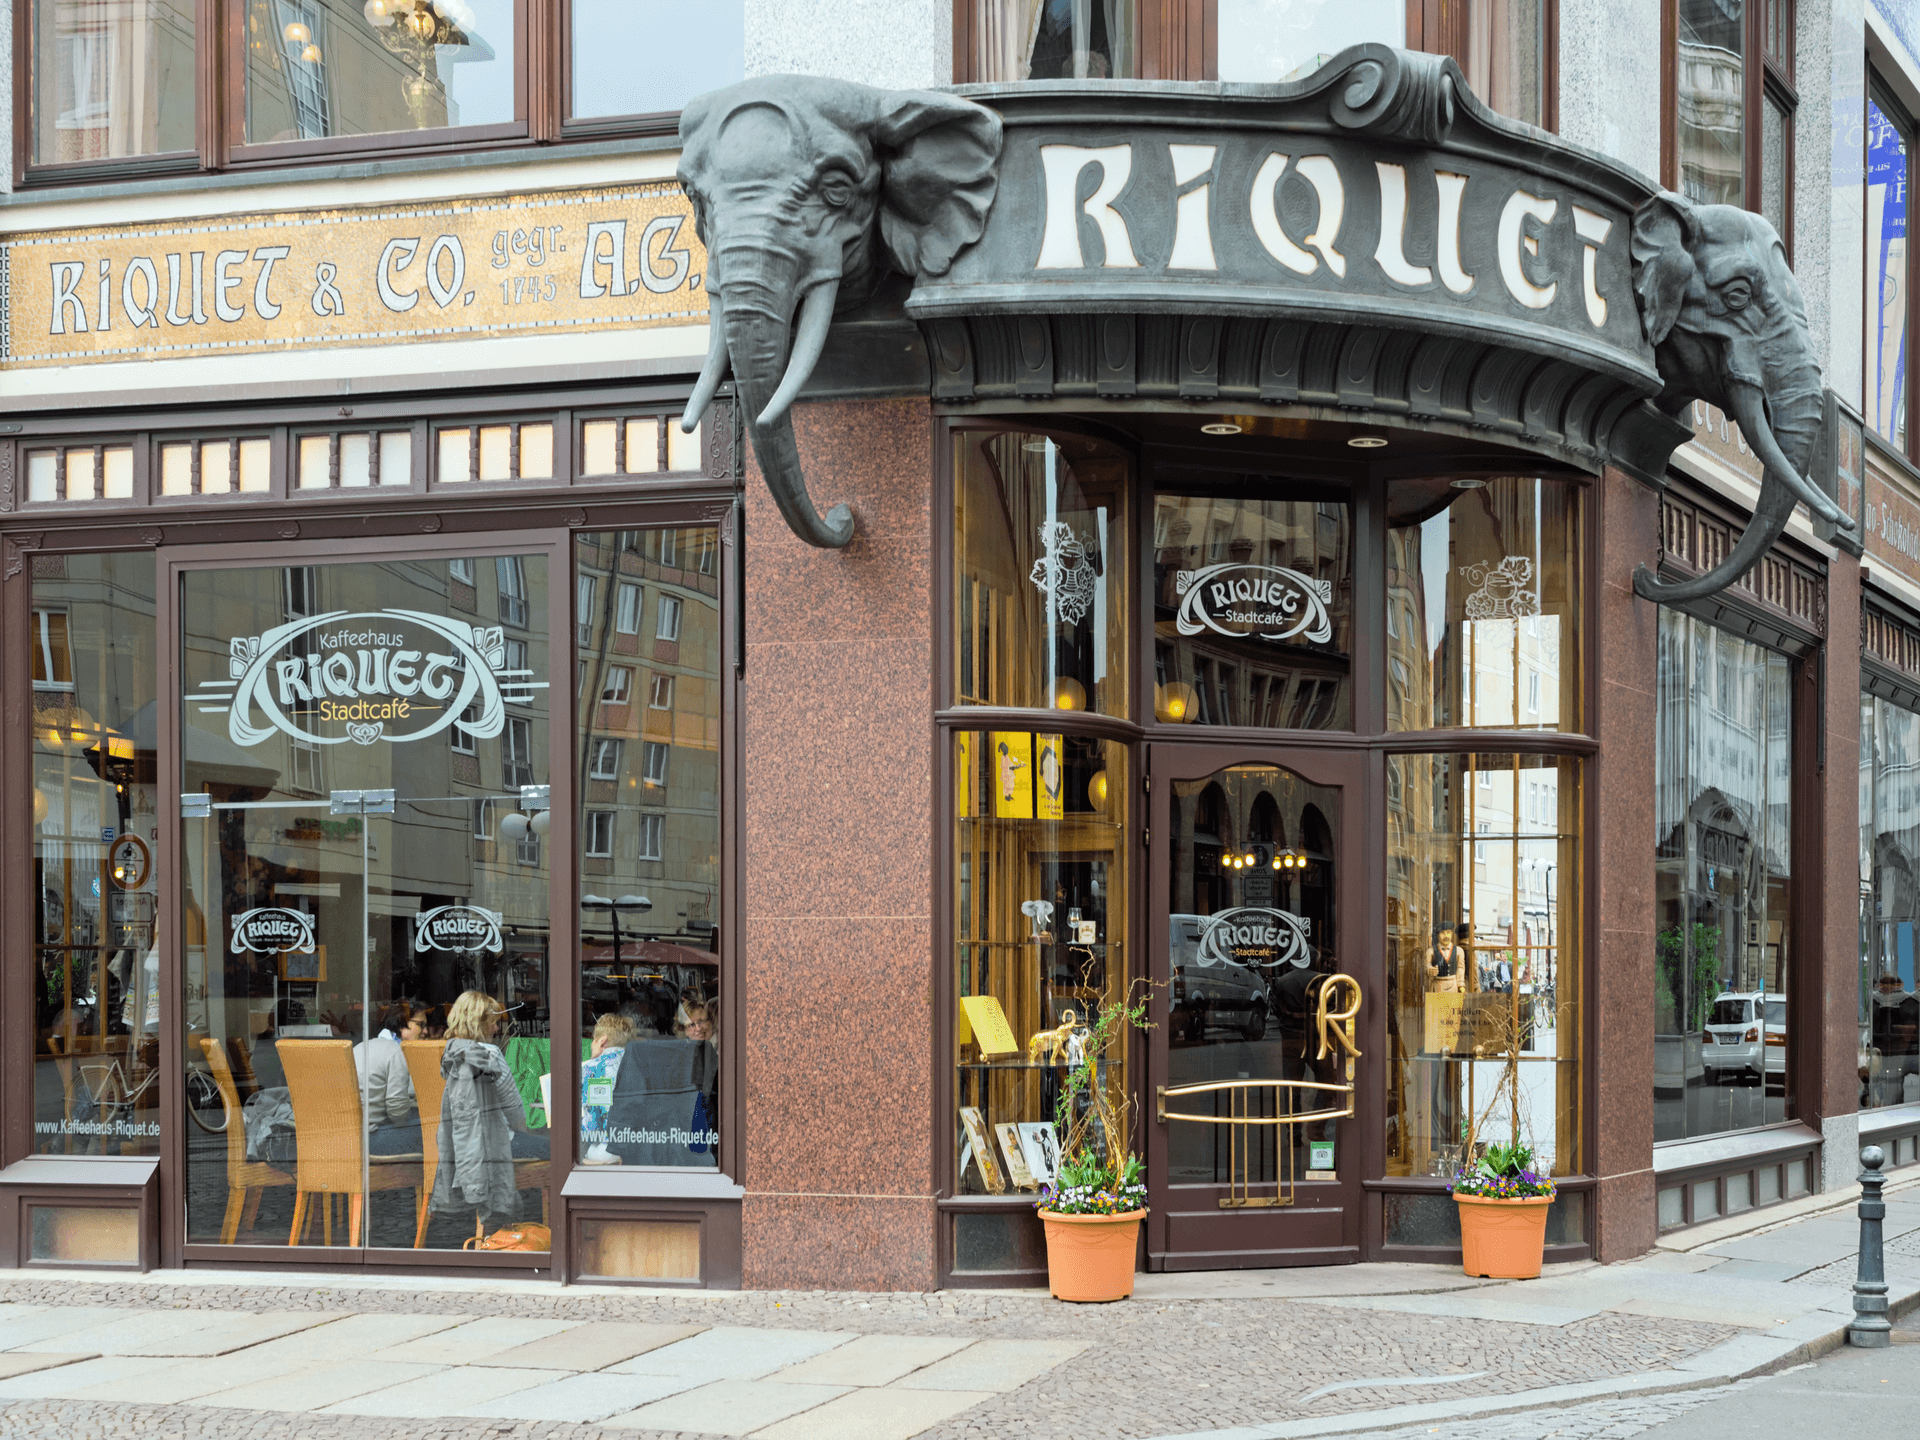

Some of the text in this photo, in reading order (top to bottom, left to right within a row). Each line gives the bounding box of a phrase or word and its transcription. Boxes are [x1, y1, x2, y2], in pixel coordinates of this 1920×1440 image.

[491, 220, 567, 269] gegr.
[311, 261, 345, 317] &
[376, 234, 476, 312] CO.
[500, 274, 558, 306] 1745
[1210, 578, 1301, 613] RIQUET
[1225, 609, 1284, 626] Stadtcafé
[319, 629, 404, 650] Kaffeehaus
[319, 698, 411, 722] Stadtcafé
[1235, 948, 1270, 957] Stadtcafé
[34, 1119, 160, 1138] www.Kaffeehaus-Riquet.de
[580, 1127, 719, 1148] www.Kaffeehaus-Riquet.de
